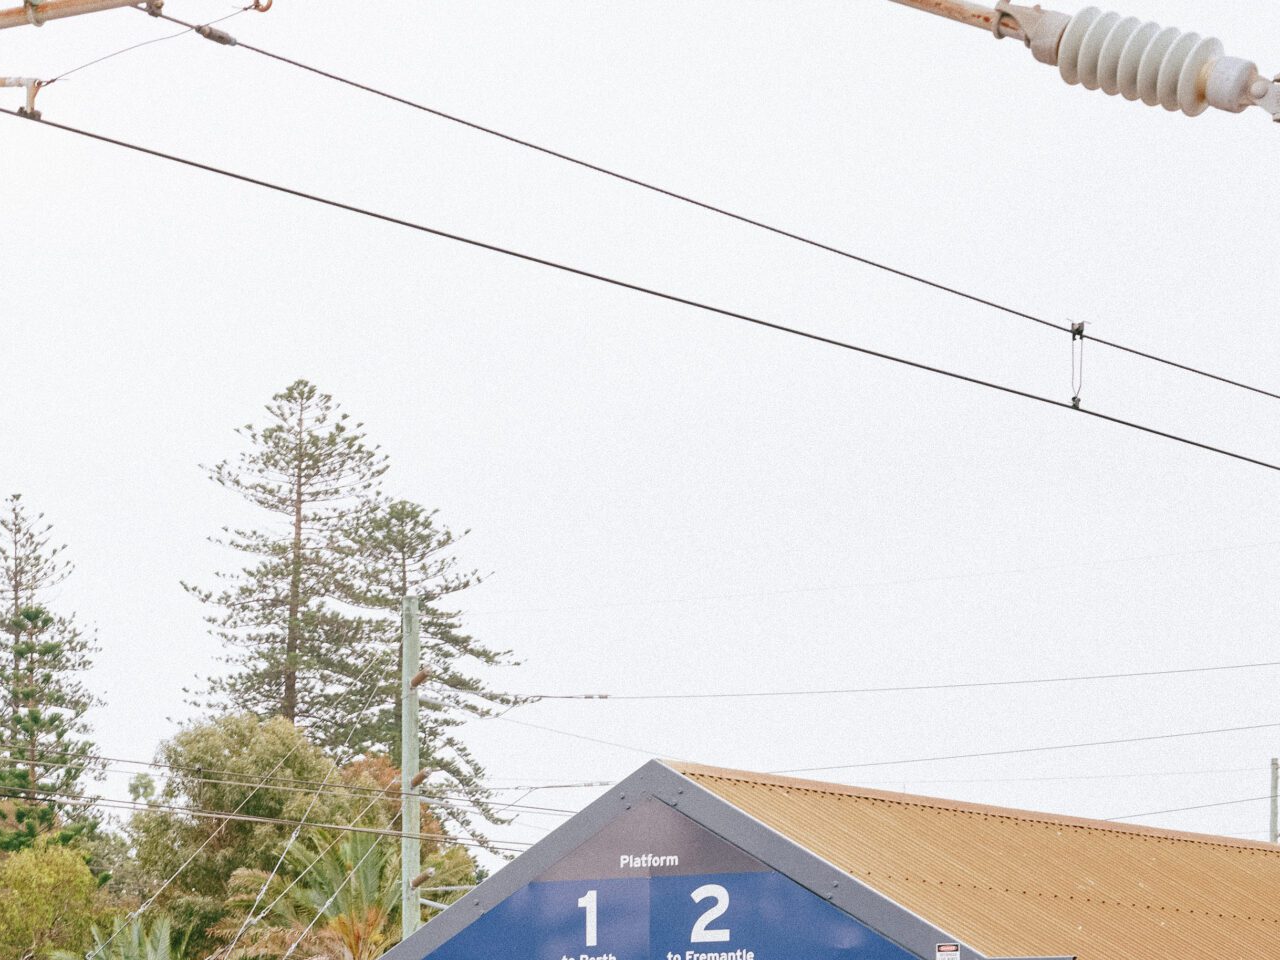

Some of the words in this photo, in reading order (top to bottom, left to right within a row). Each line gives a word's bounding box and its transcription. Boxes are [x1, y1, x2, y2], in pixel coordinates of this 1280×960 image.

[620, 854, 678, 868] Platform
[578, 890, 597, 947] 1
[690, 884, 730, 943] 2
